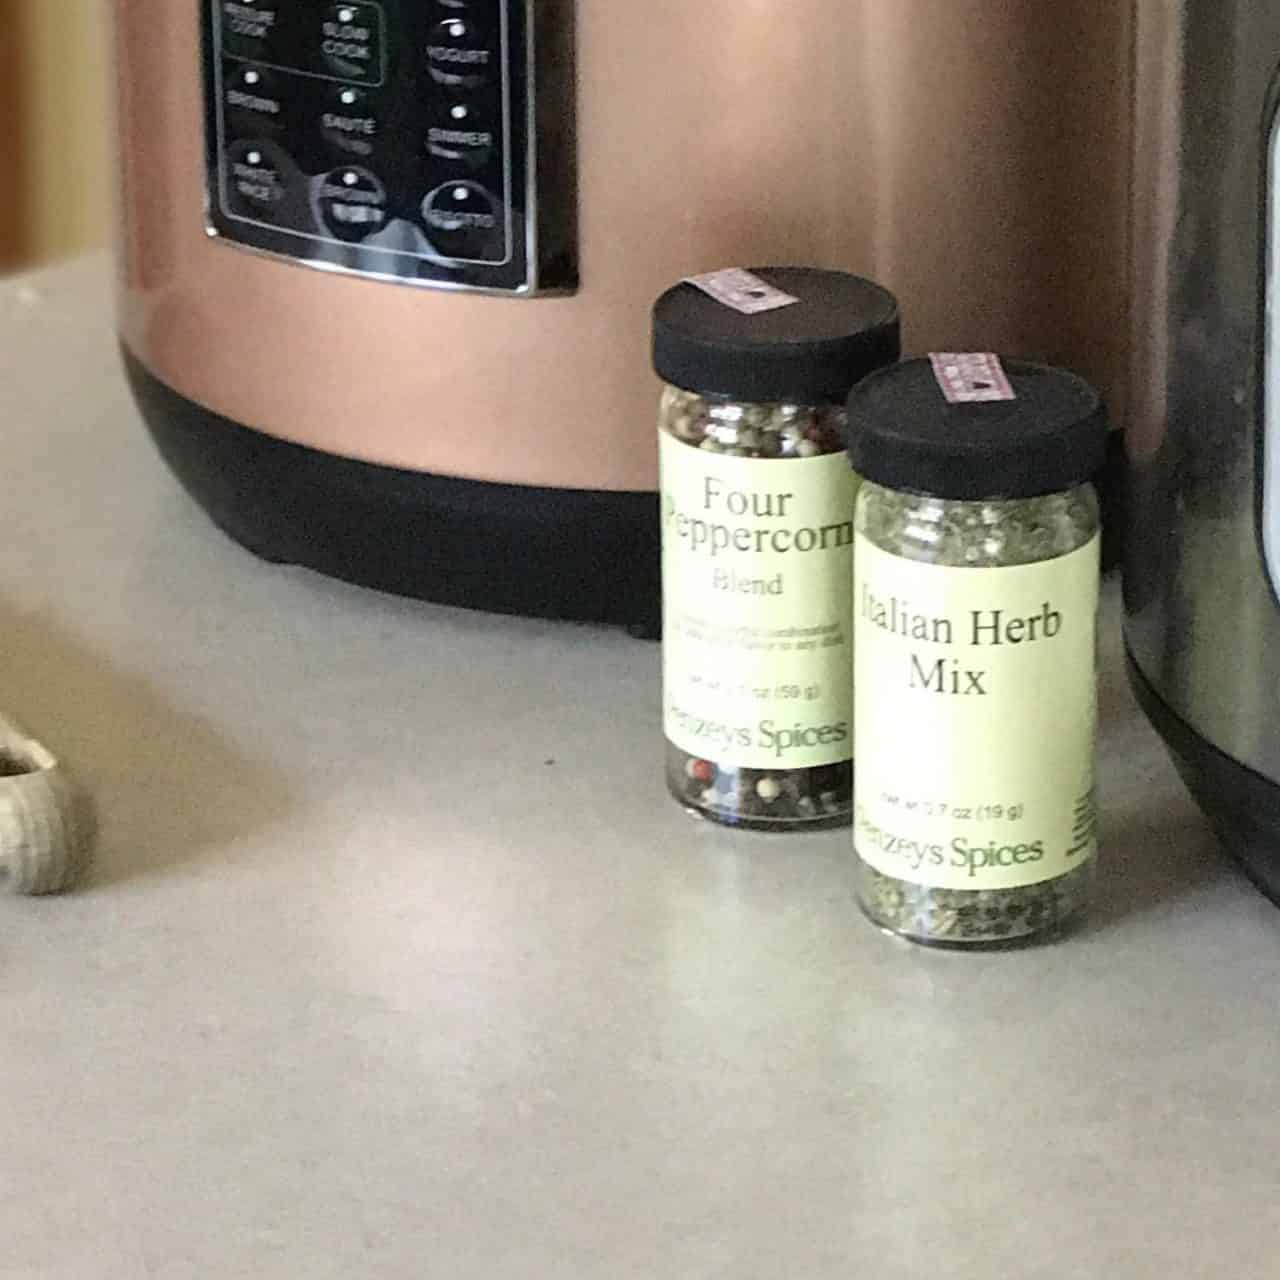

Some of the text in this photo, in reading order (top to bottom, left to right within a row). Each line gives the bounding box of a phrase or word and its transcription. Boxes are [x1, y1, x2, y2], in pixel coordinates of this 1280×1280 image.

[321, 39, 371, 59] COOK
[426, 45, 490, 64] YOGURT
[703, 476, 793, 517] Four
[713, 567, 784, 596] Blend
[861, 583, 952, 644] Italian
[970, 601, 1063, 646] Herb
[910, 654, 987, 696] Mix
[757, 719, 848, 758] Spices
[950, 835, 1045, 877] Spices
